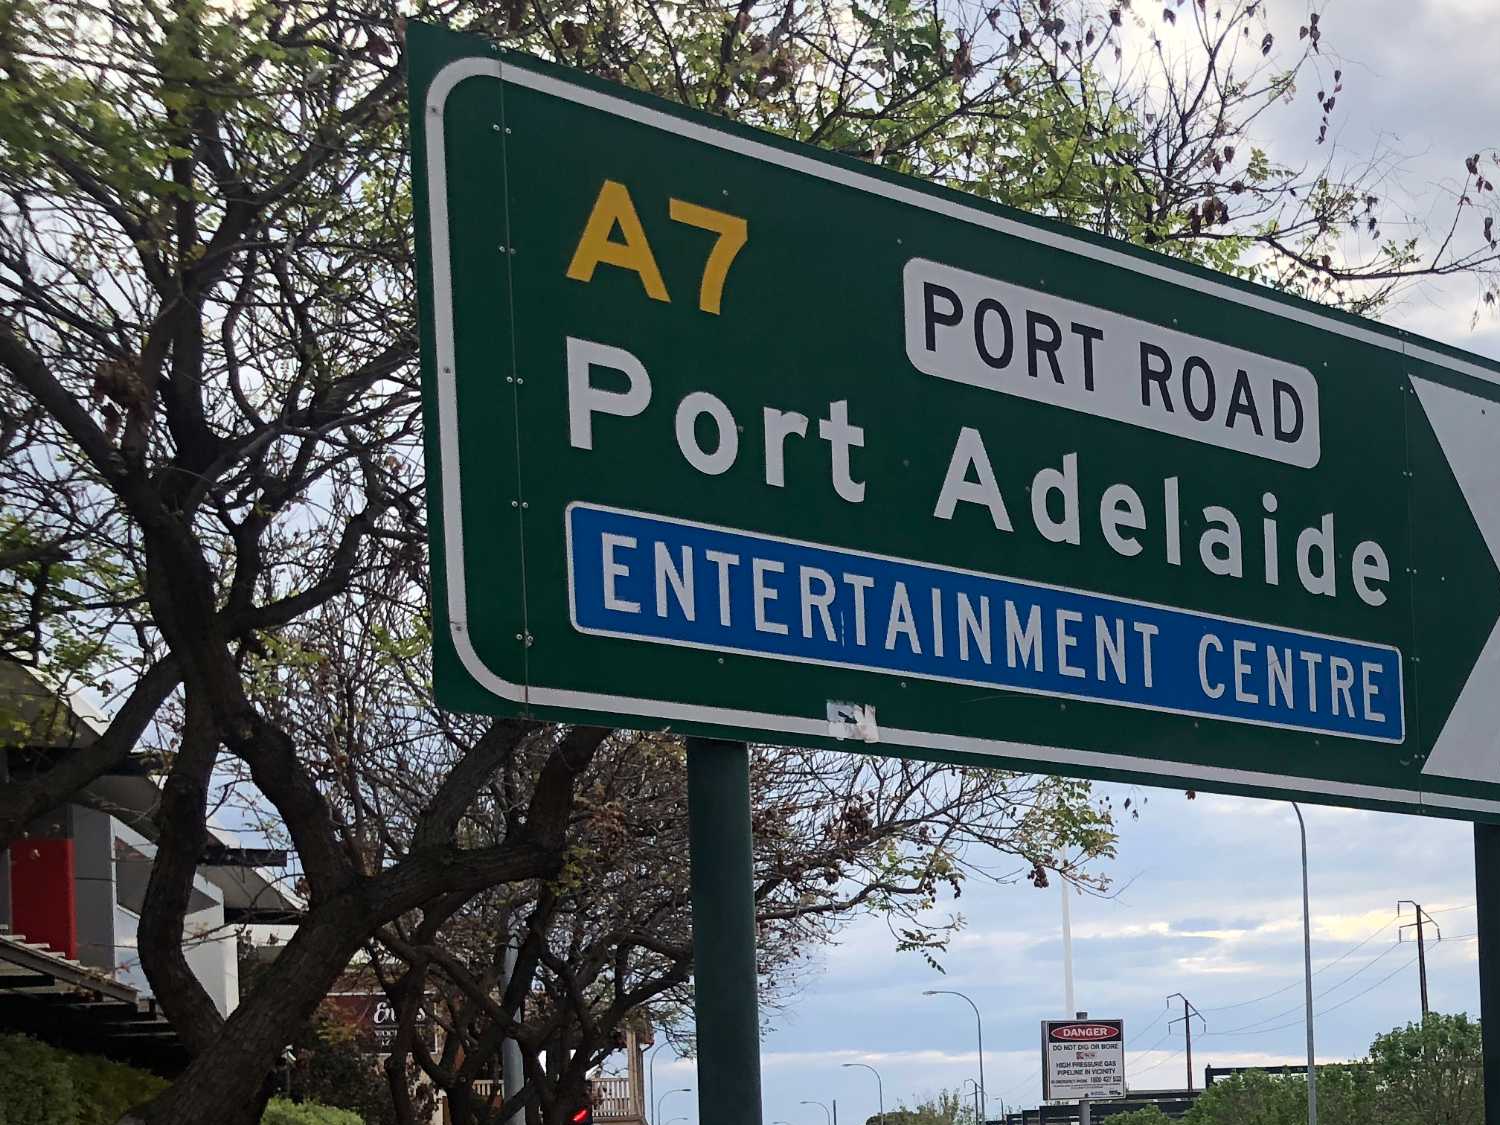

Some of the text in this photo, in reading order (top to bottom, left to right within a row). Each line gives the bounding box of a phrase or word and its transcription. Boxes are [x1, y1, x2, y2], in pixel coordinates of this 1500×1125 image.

[566, 179, 748, 315] A7
[923, 282, 1305, 444] PORT ROAD
[566, 336, 1391, 607] Port Adelaide
[601, 532, 1387, 723] ENTERTAINMENT CENTRE
[1063, 1028, 1108, 1037] DANGER
